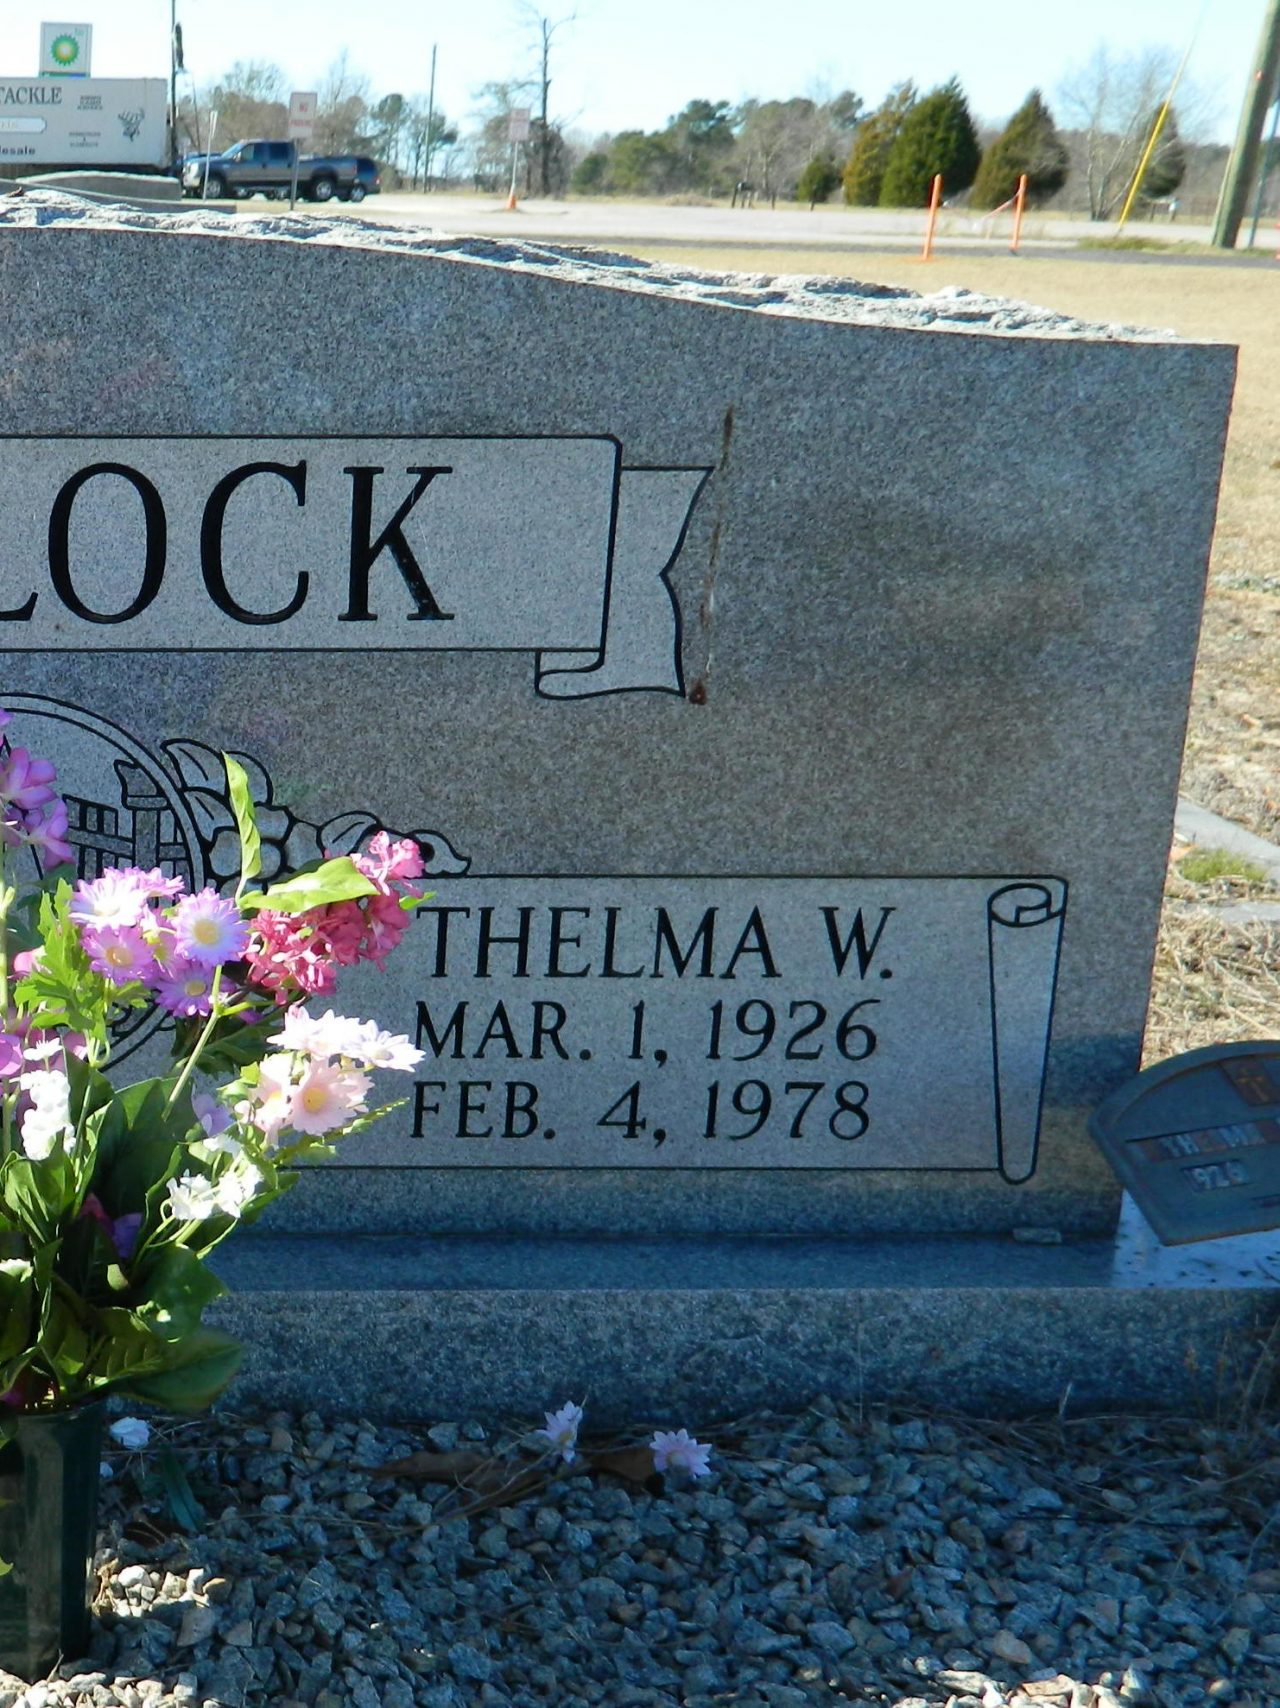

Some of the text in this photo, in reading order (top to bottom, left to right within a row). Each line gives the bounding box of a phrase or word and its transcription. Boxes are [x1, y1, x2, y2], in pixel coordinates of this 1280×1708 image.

[417, 905, 897, 980] THELMA W.
[415, 998, 881, 1068] MAR. 1, 1926
[409, 1079, 870, 1148] FEB. 4, 1978
